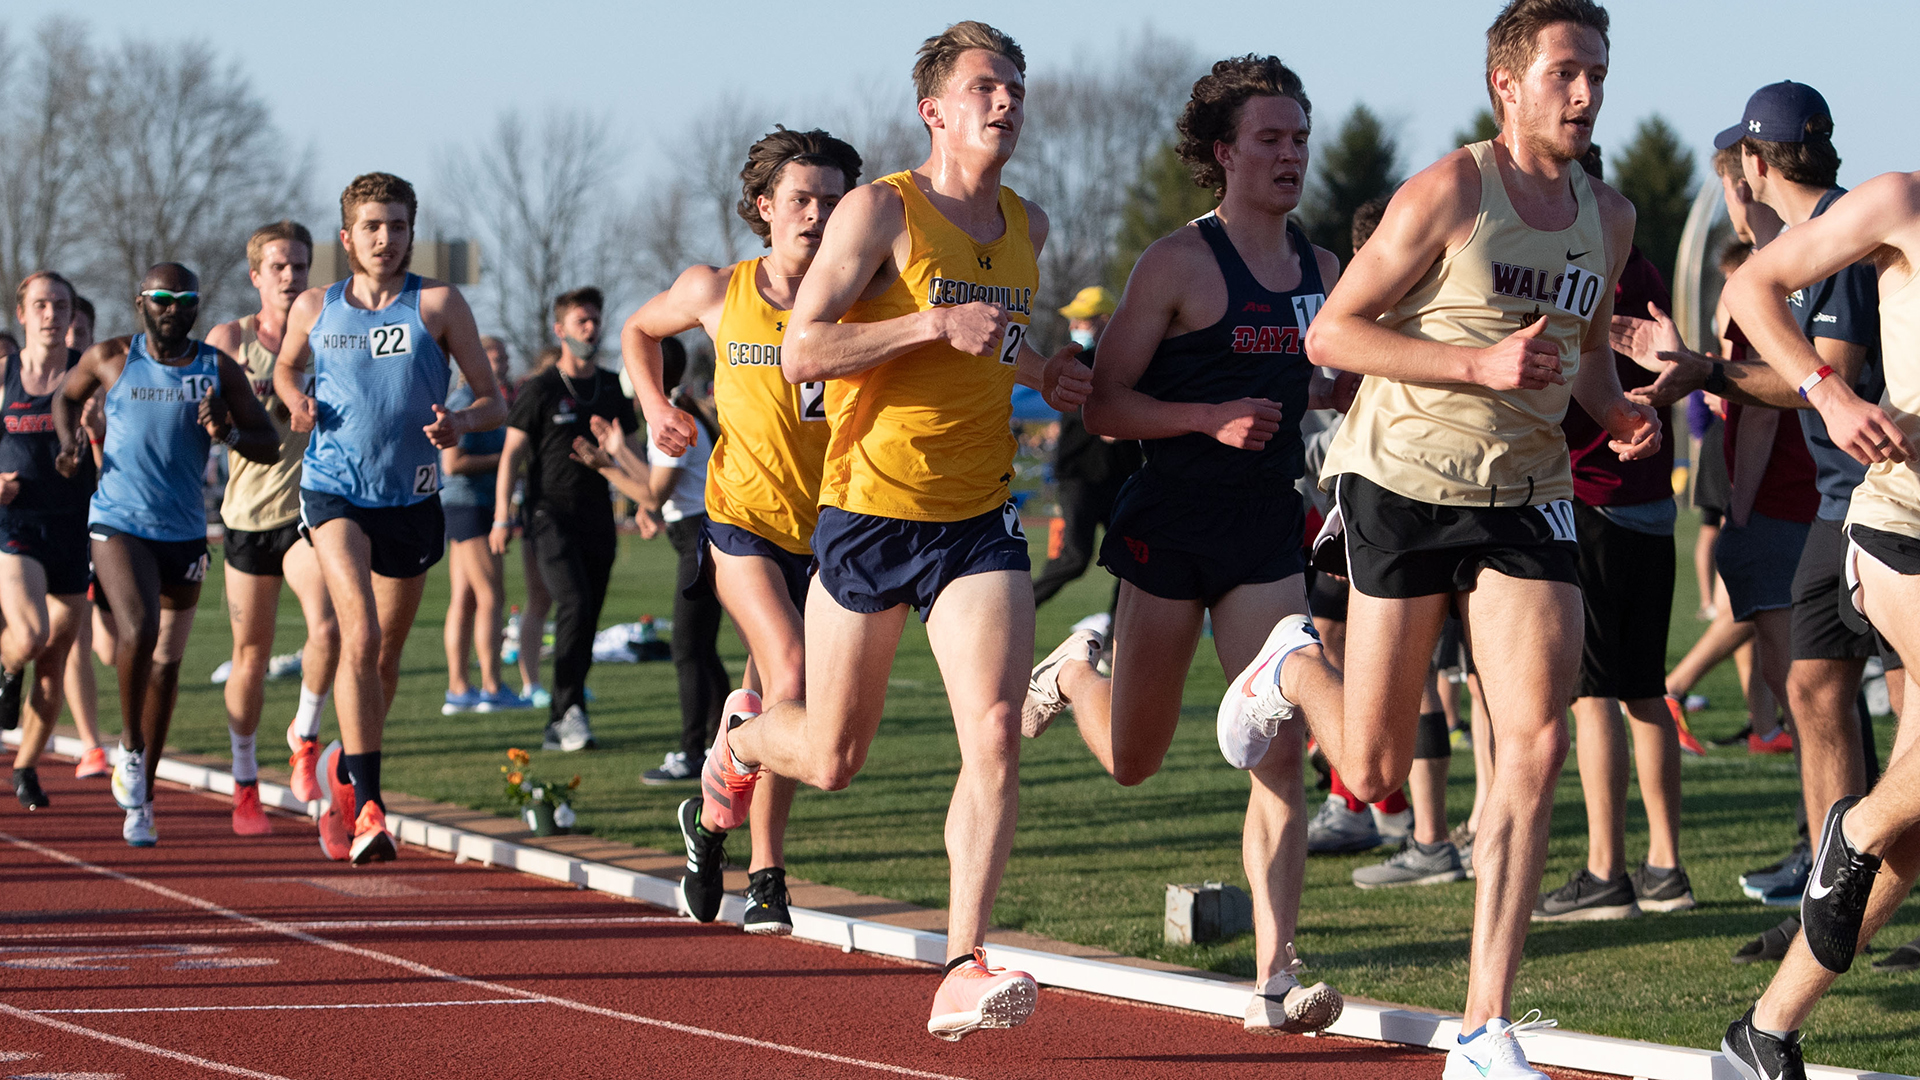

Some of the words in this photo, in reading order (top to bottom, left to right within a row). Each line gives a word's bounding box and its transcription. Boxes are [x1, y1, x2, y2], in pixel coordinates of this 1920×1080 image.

[1567, 269, 1599, 317] 10
[323, 334, 368, 349] NORTH
[373, 327, 406, 356] 22
[186, 376, 213, 400] 19
[1543, 503, 1575, 538] 10
